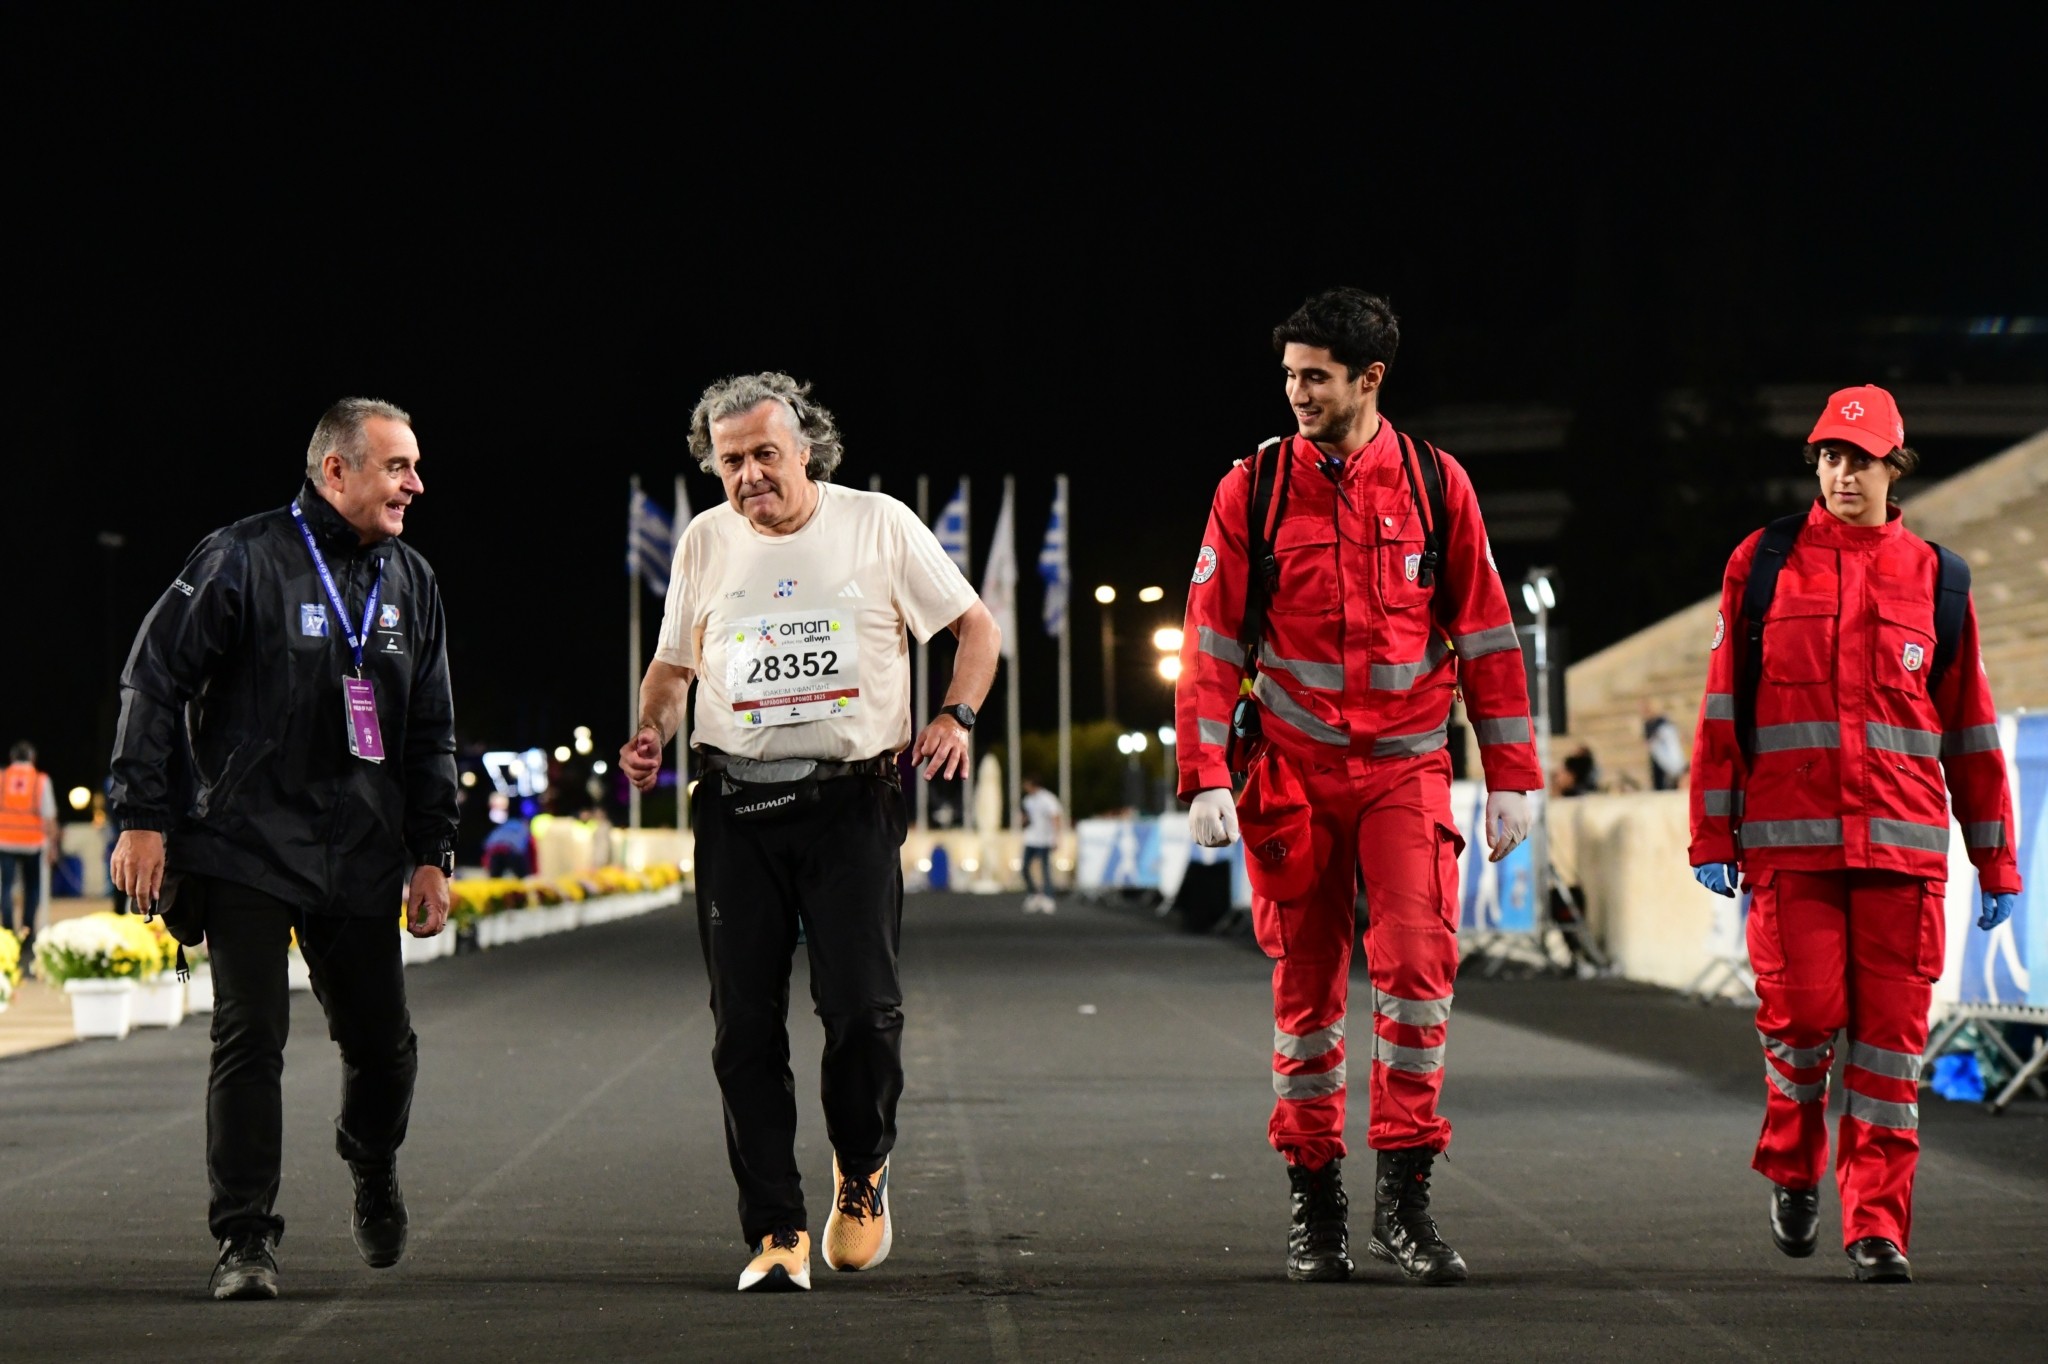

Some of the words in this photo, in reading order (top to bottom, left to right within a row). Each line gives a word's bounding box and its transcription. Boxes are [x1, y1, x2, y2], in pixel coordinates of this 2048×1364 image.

[804, 635, 830, 644] allwyn
[746, 650, 839, 684] 28352
[735, 793, 796, 815] SALOMON
